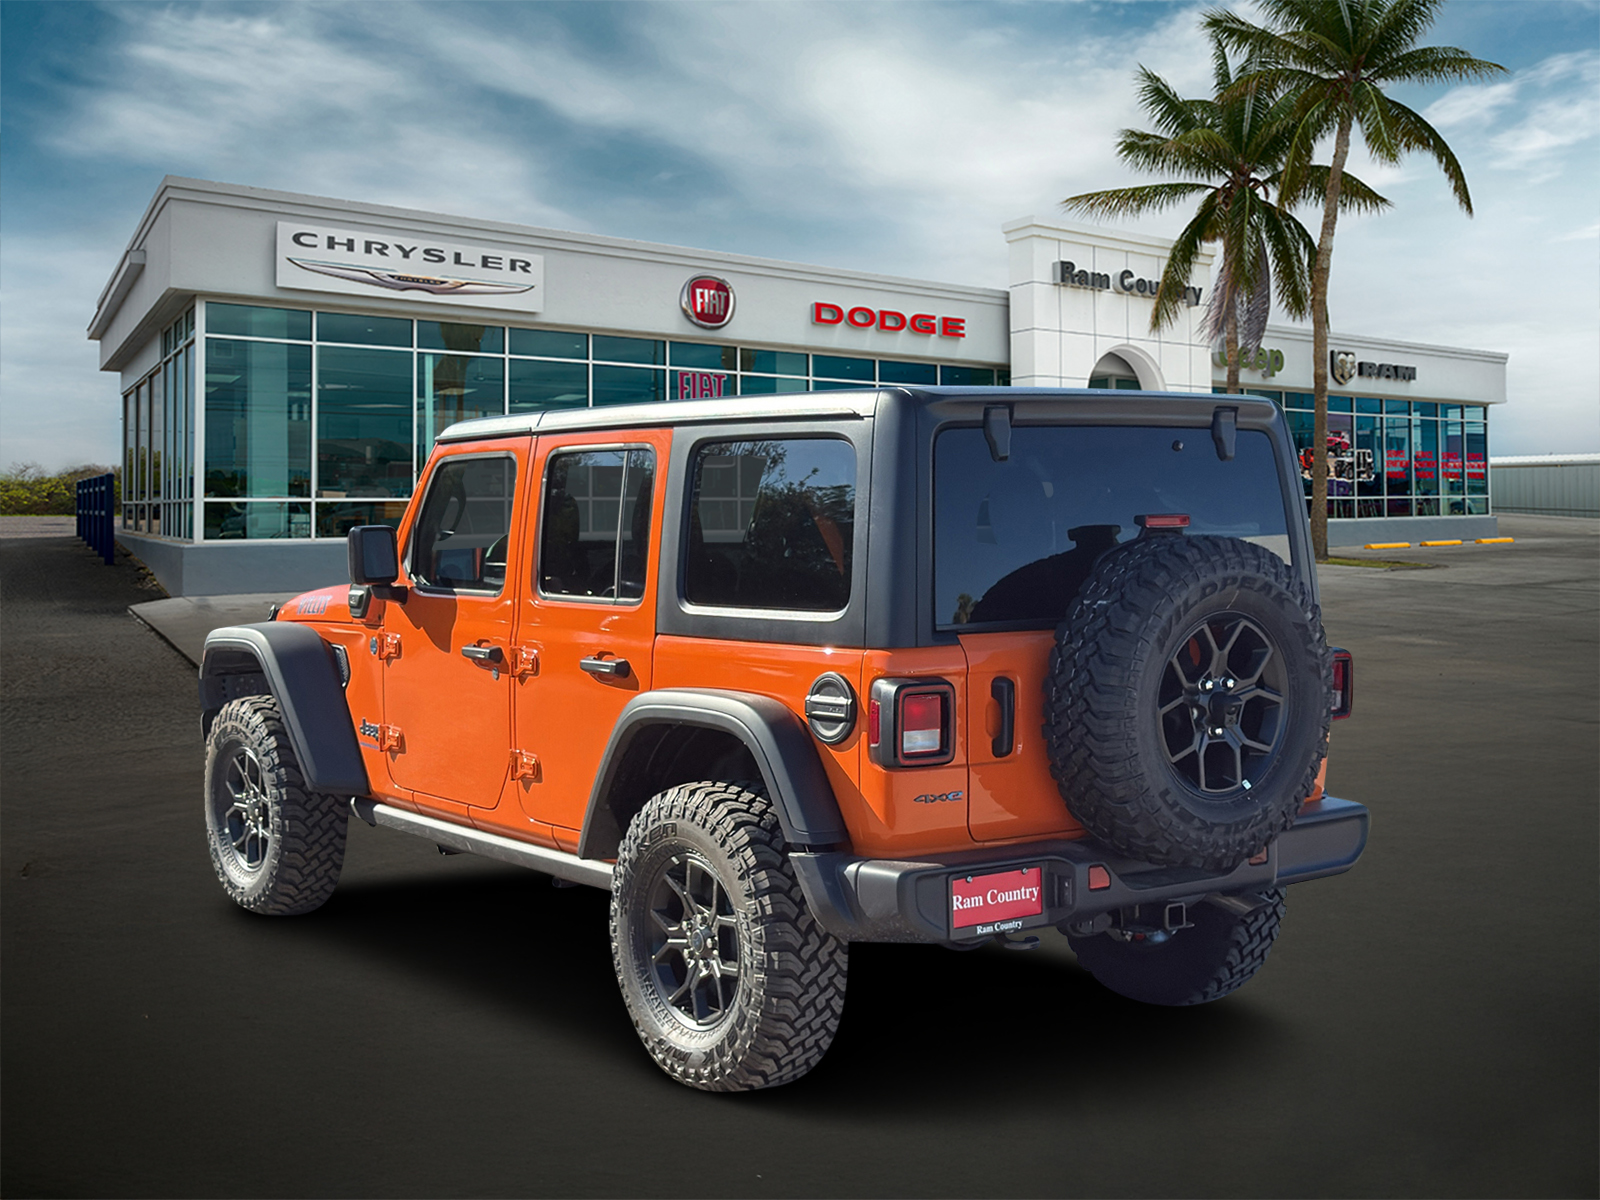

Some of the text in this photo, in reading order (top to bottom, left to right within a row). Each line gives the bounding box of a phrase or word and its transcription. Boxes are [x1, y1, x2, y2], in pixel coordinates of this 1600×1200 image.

[291, 232, 533, 274] CHRYSLER
[1055, 260, 1203, 306] Ram Coury
[695, 287, 728, 316] FIAT
[811, 301, 967, 339] DODGE
[677, 371, 727, 400] FIAT
[1358, 362, 1417, 381] RAM
[952, 885, 1040, 911] Ram Country
[976, 924, 994, 935] Ram
[994, 919, 1023, 932] Country
